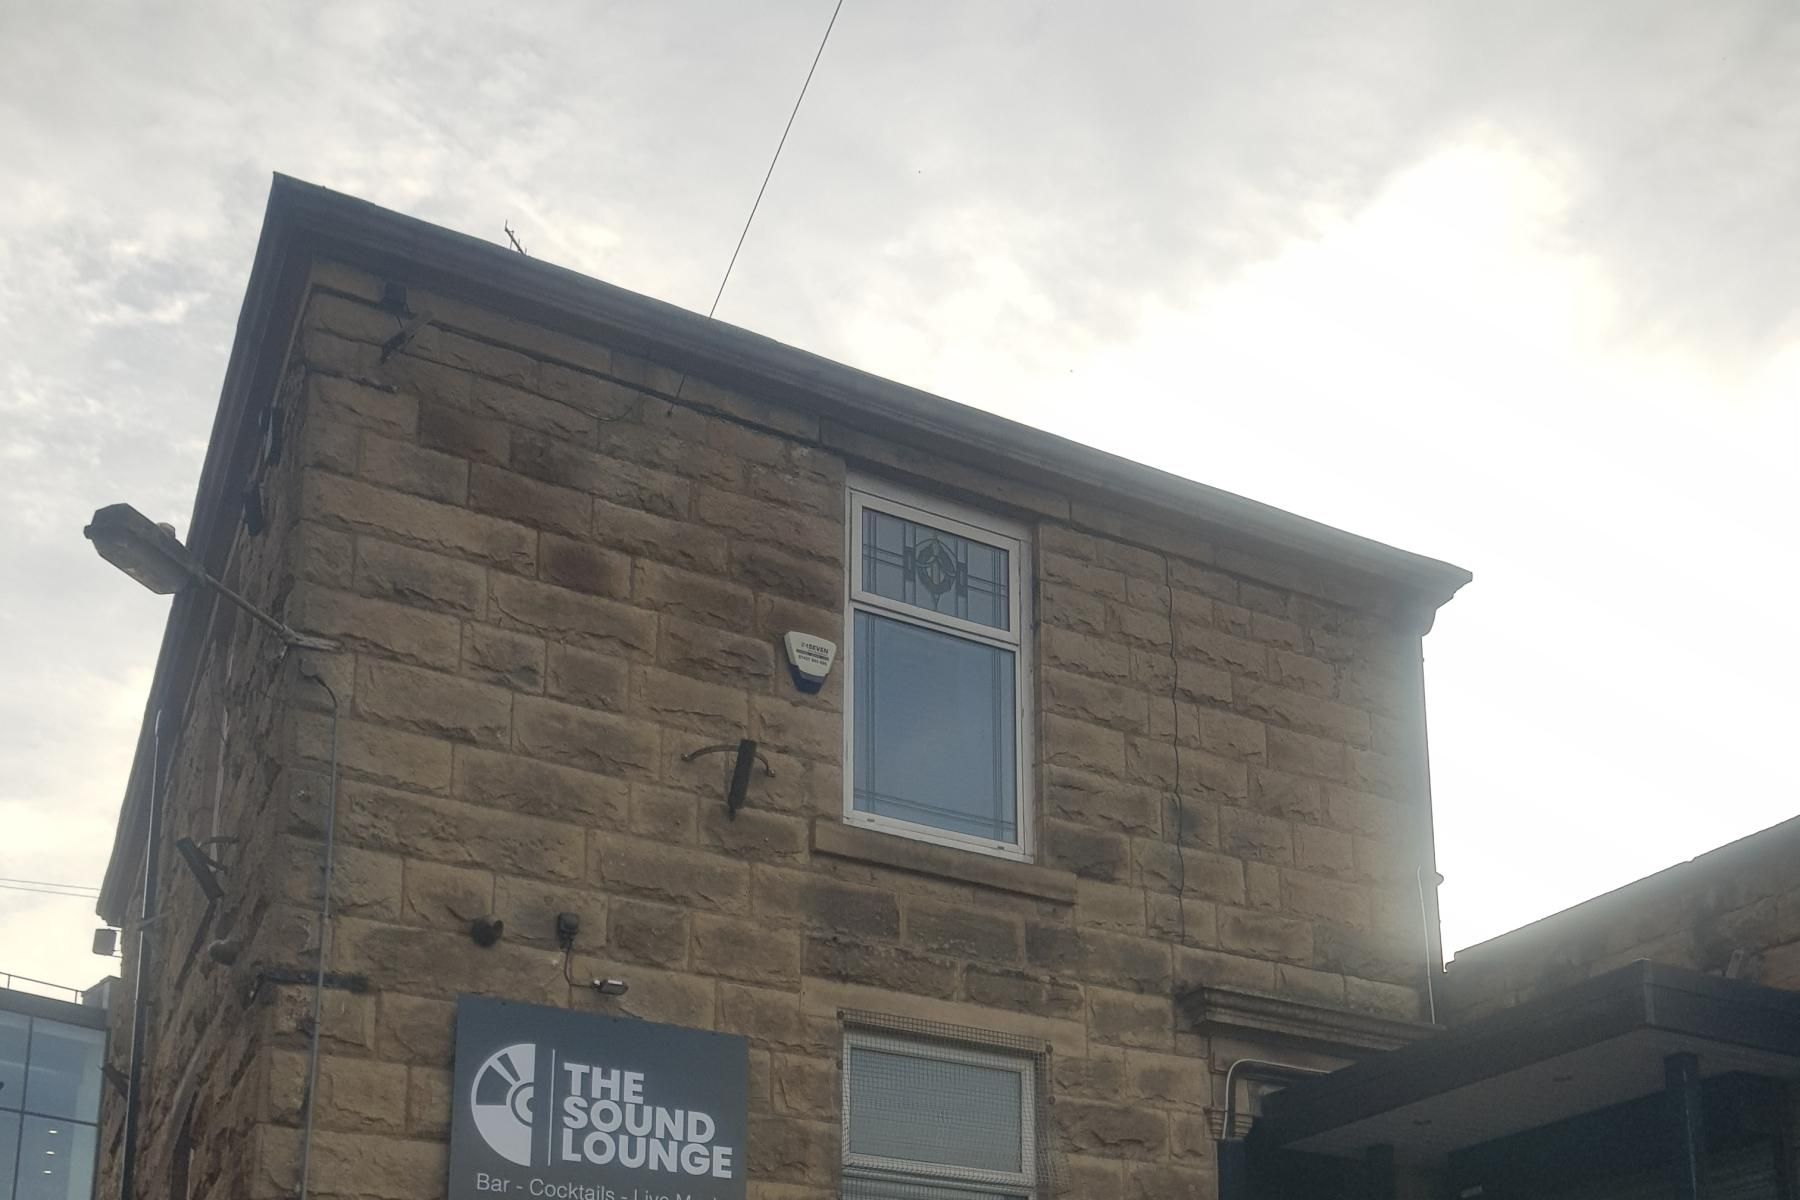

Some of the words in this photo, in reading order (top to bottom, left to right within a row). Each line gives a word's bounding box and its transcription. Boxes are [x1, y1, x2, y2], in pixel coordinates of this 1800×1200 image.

[564, 1062, 645, 1104] THE
[563, 1096, 715, 1144] SOUND
[562, 1128, 733, 1179] LOUNGE
[477, 1173, 511, 1193] Bar
